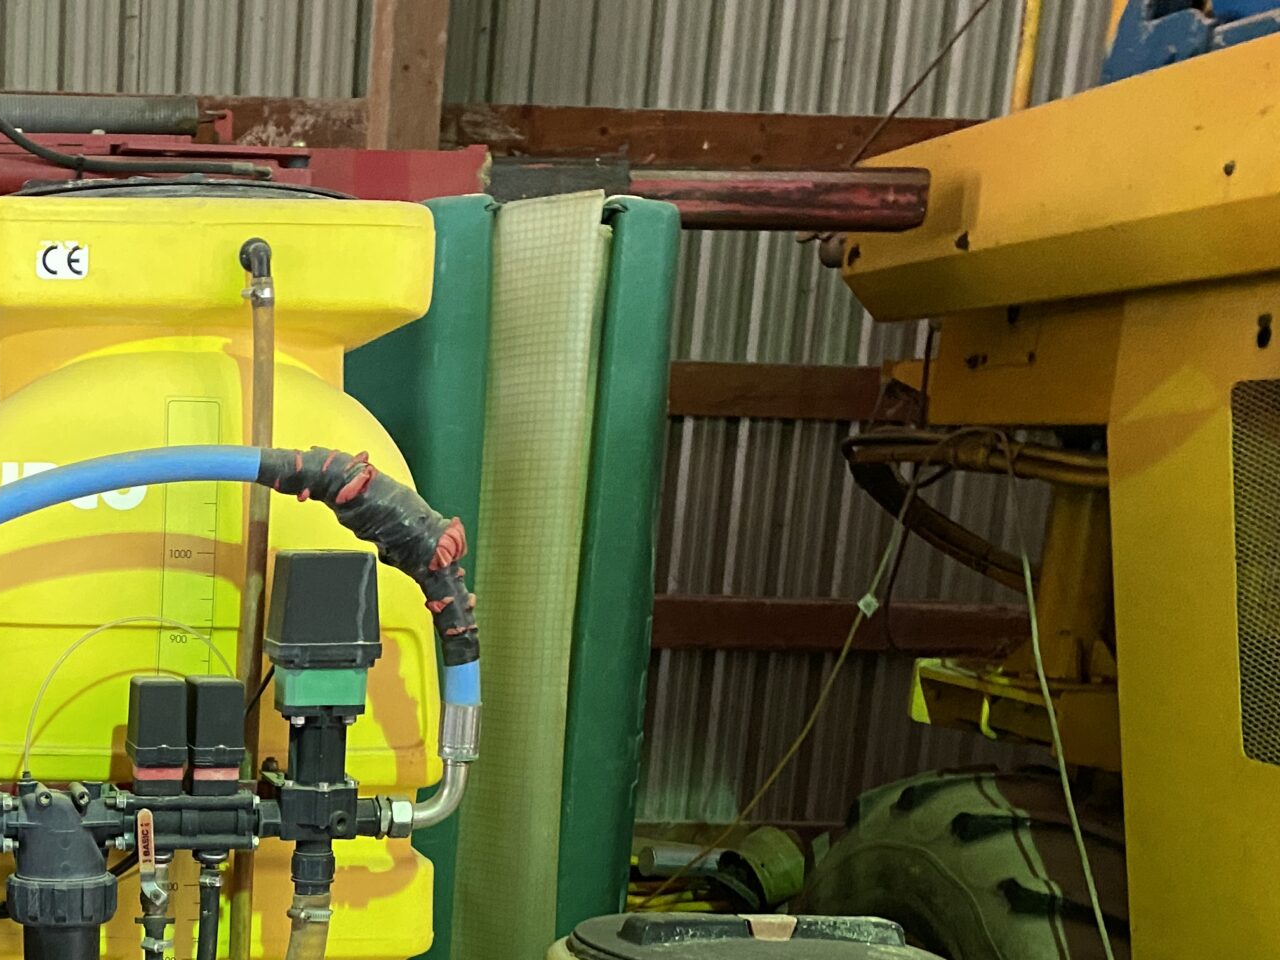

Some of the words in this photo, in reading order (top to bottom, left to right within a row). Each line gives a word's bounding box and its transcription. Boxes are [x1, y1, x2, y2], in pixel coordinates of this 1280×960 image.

[41, 244, 83, 275] CE
[169, 549, 192, 559] 1000
[169, 634, 187, 644] 900
[142, 828, 150, 858] BASIC
